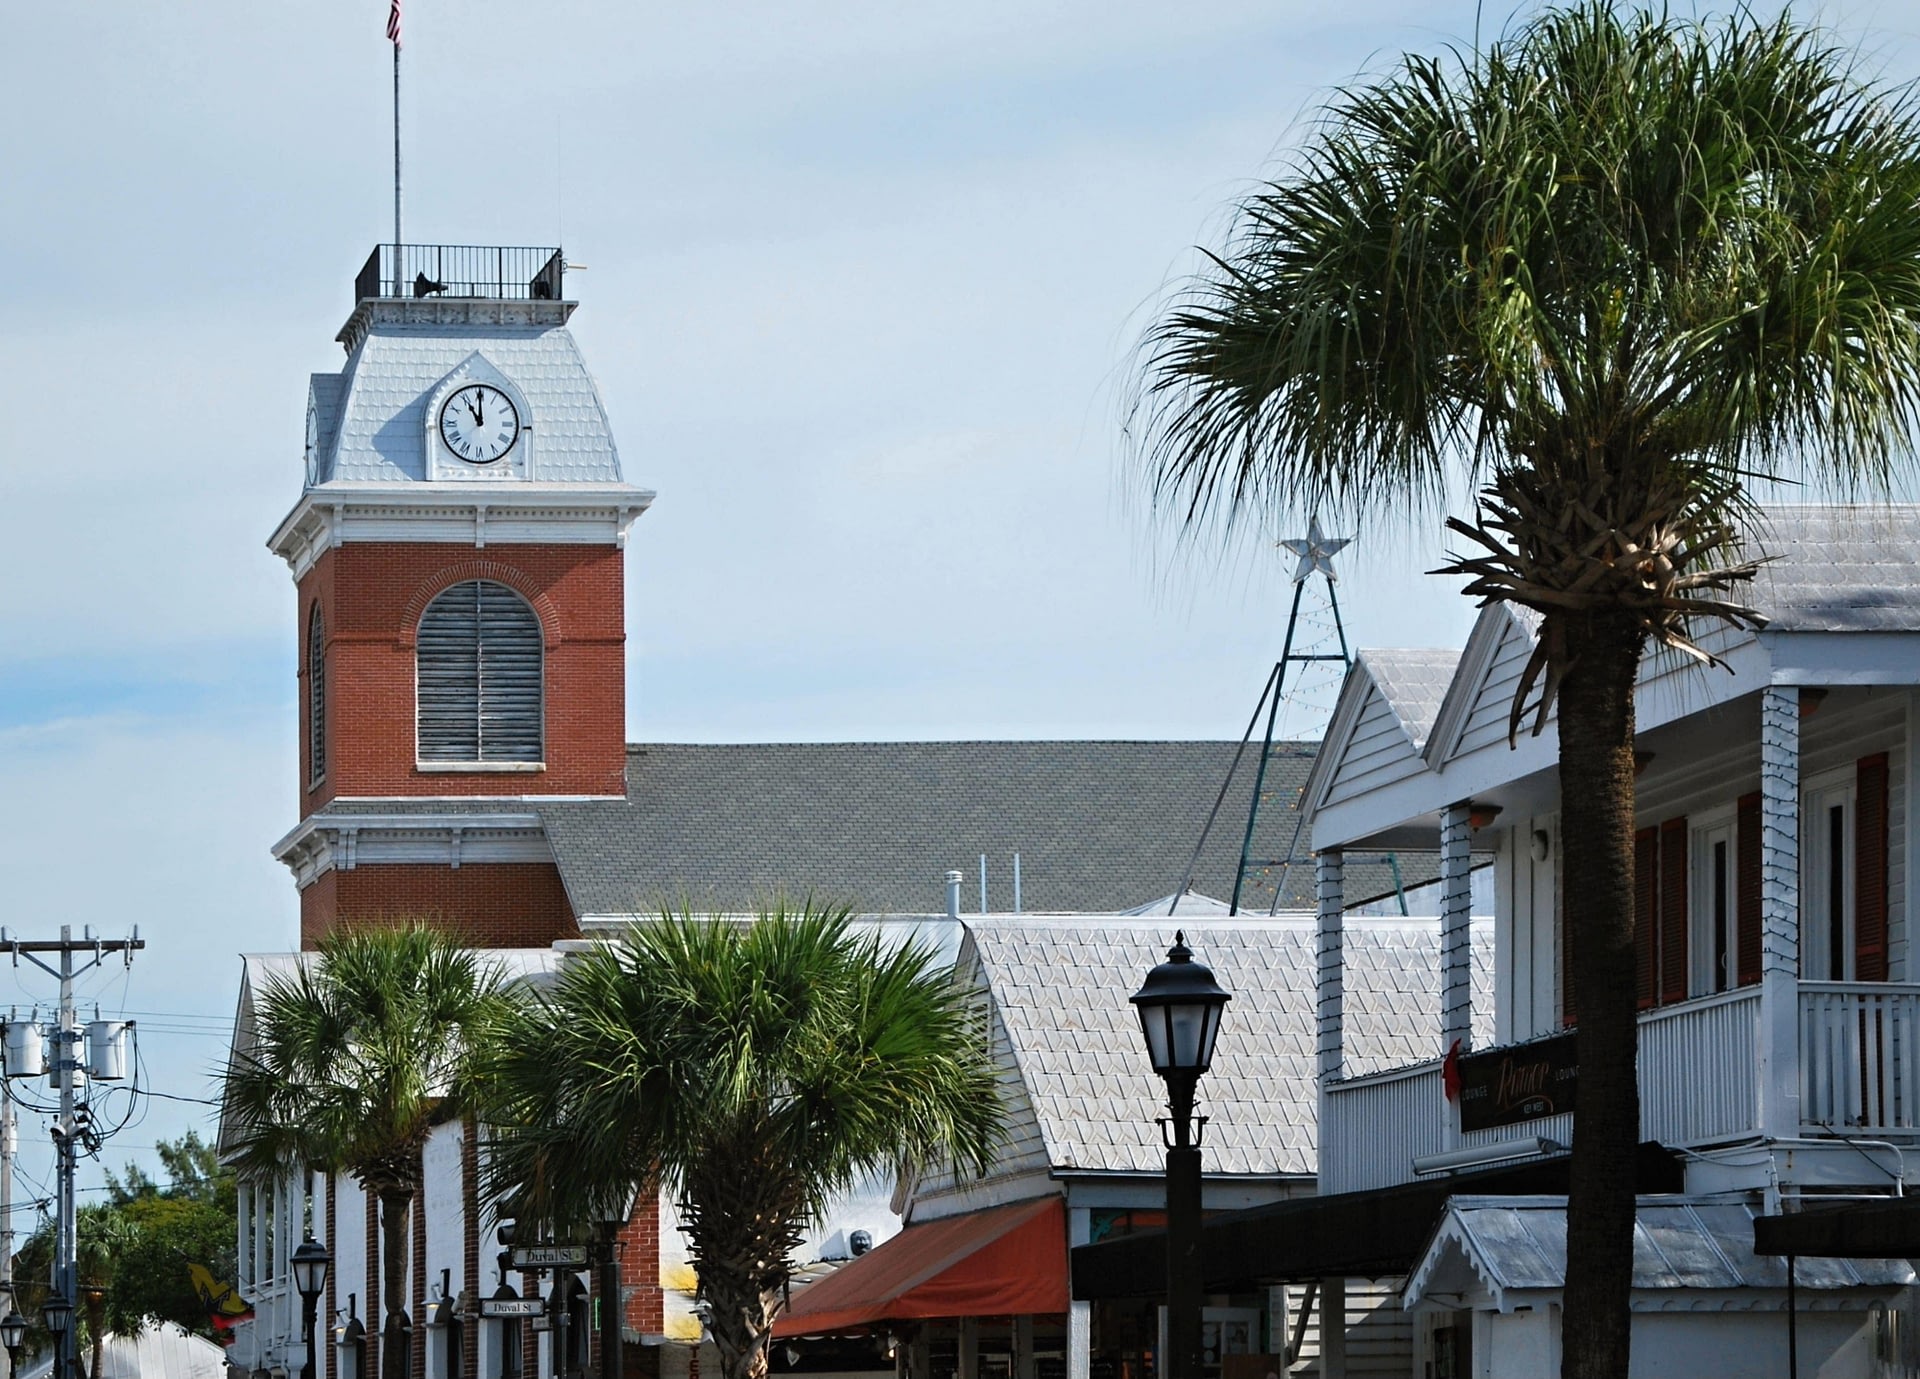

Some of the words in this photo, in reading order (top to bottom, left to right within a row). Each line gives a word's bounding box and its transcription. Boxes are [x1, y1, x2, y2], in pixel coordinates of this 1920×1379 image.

[1555, 1065, 1580, 1081] LOUNG
[528, 1250, 558, 1262] Duval
[561, 1250, 573, 1261] St
[494, 1303, 520, 1312] Duval
[522, 1303, 531, 1312] St
